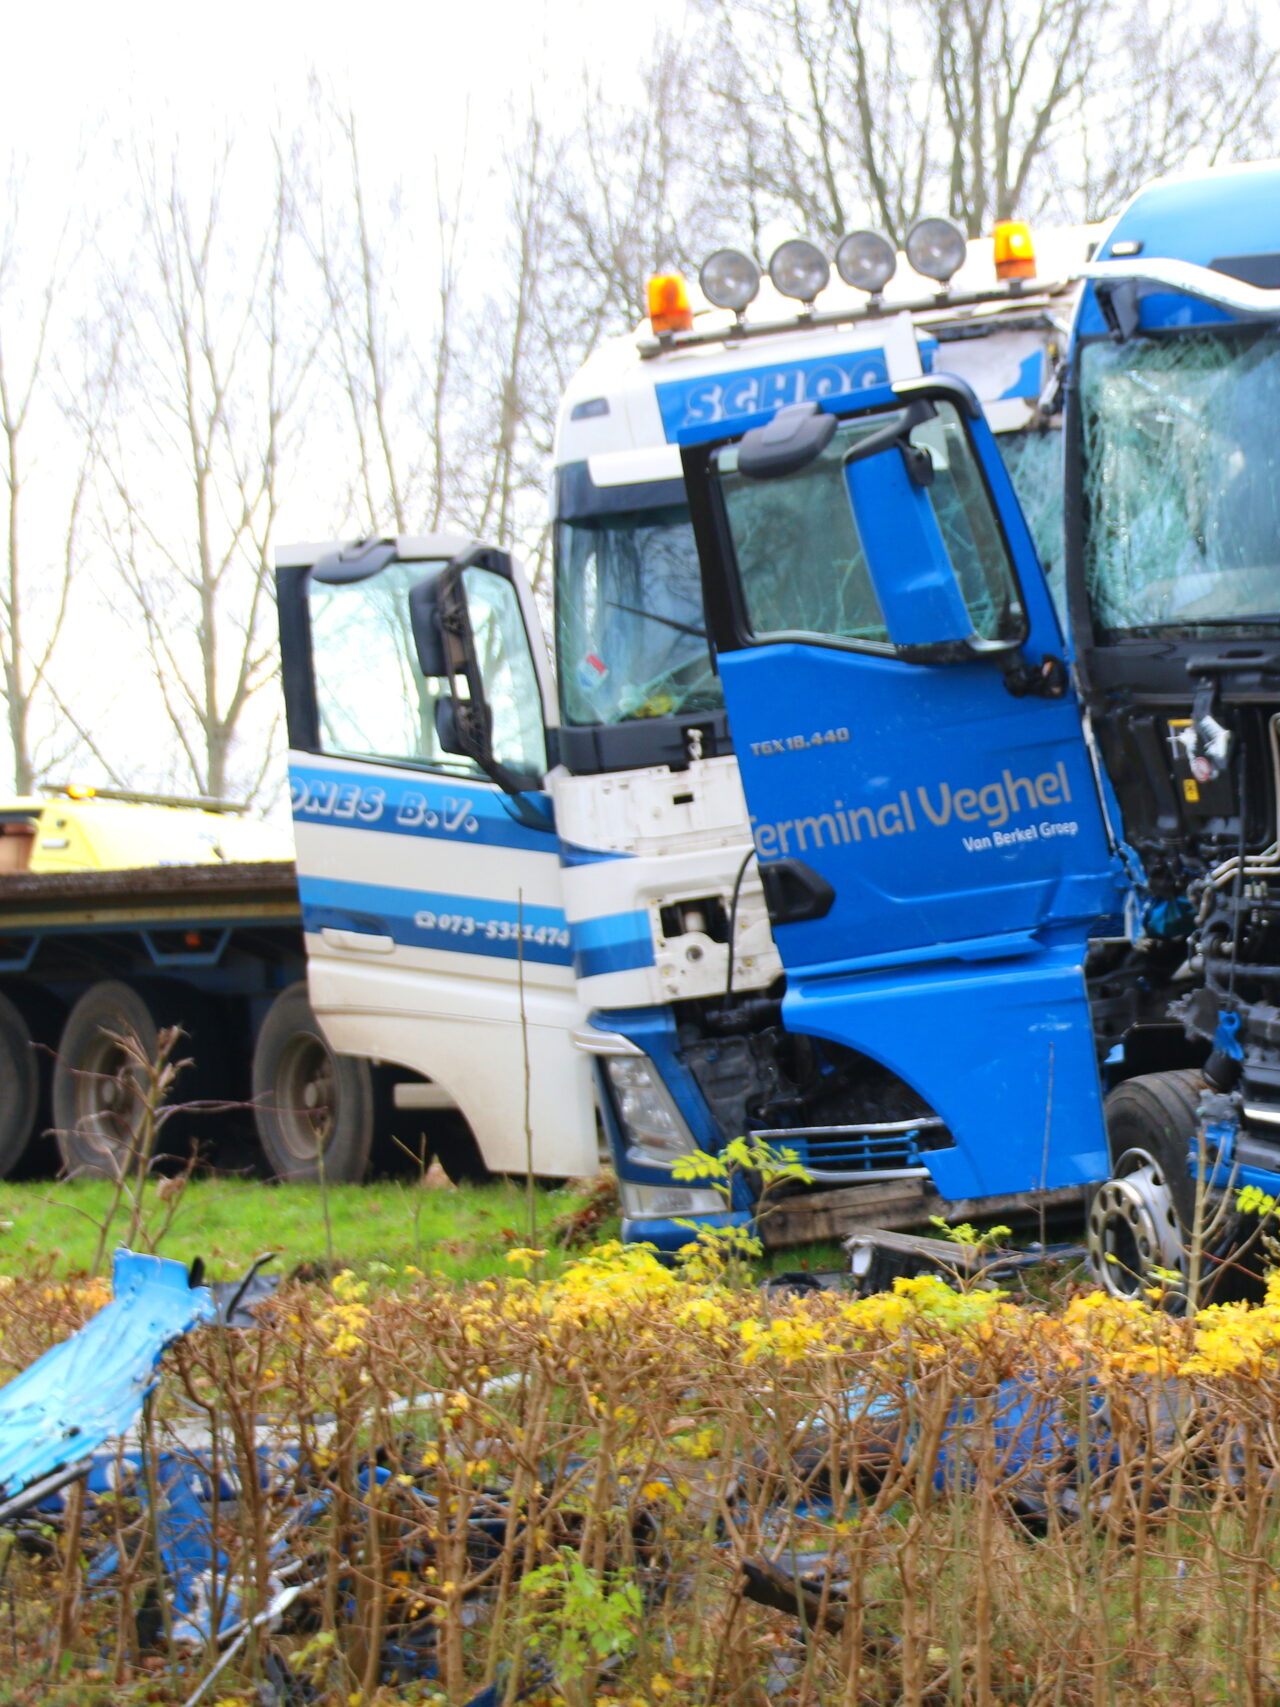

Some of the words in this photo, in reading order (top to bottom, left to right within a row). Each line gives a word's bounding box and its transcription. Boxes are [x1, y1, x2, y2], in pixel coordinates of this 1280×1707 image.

[750, 742, 785, 756] TGX
[786, 727, 849, 750] 18.440
[396, 791, 478, 833] B.V.
[749, 790, 916, 857] erminal
[917, 761, 1072, 827] Veghel
[962, 836, 992, 852] Van
[992, 824, 1038, 847] Berkel
[1039, 821, 1078, 838] Groep
